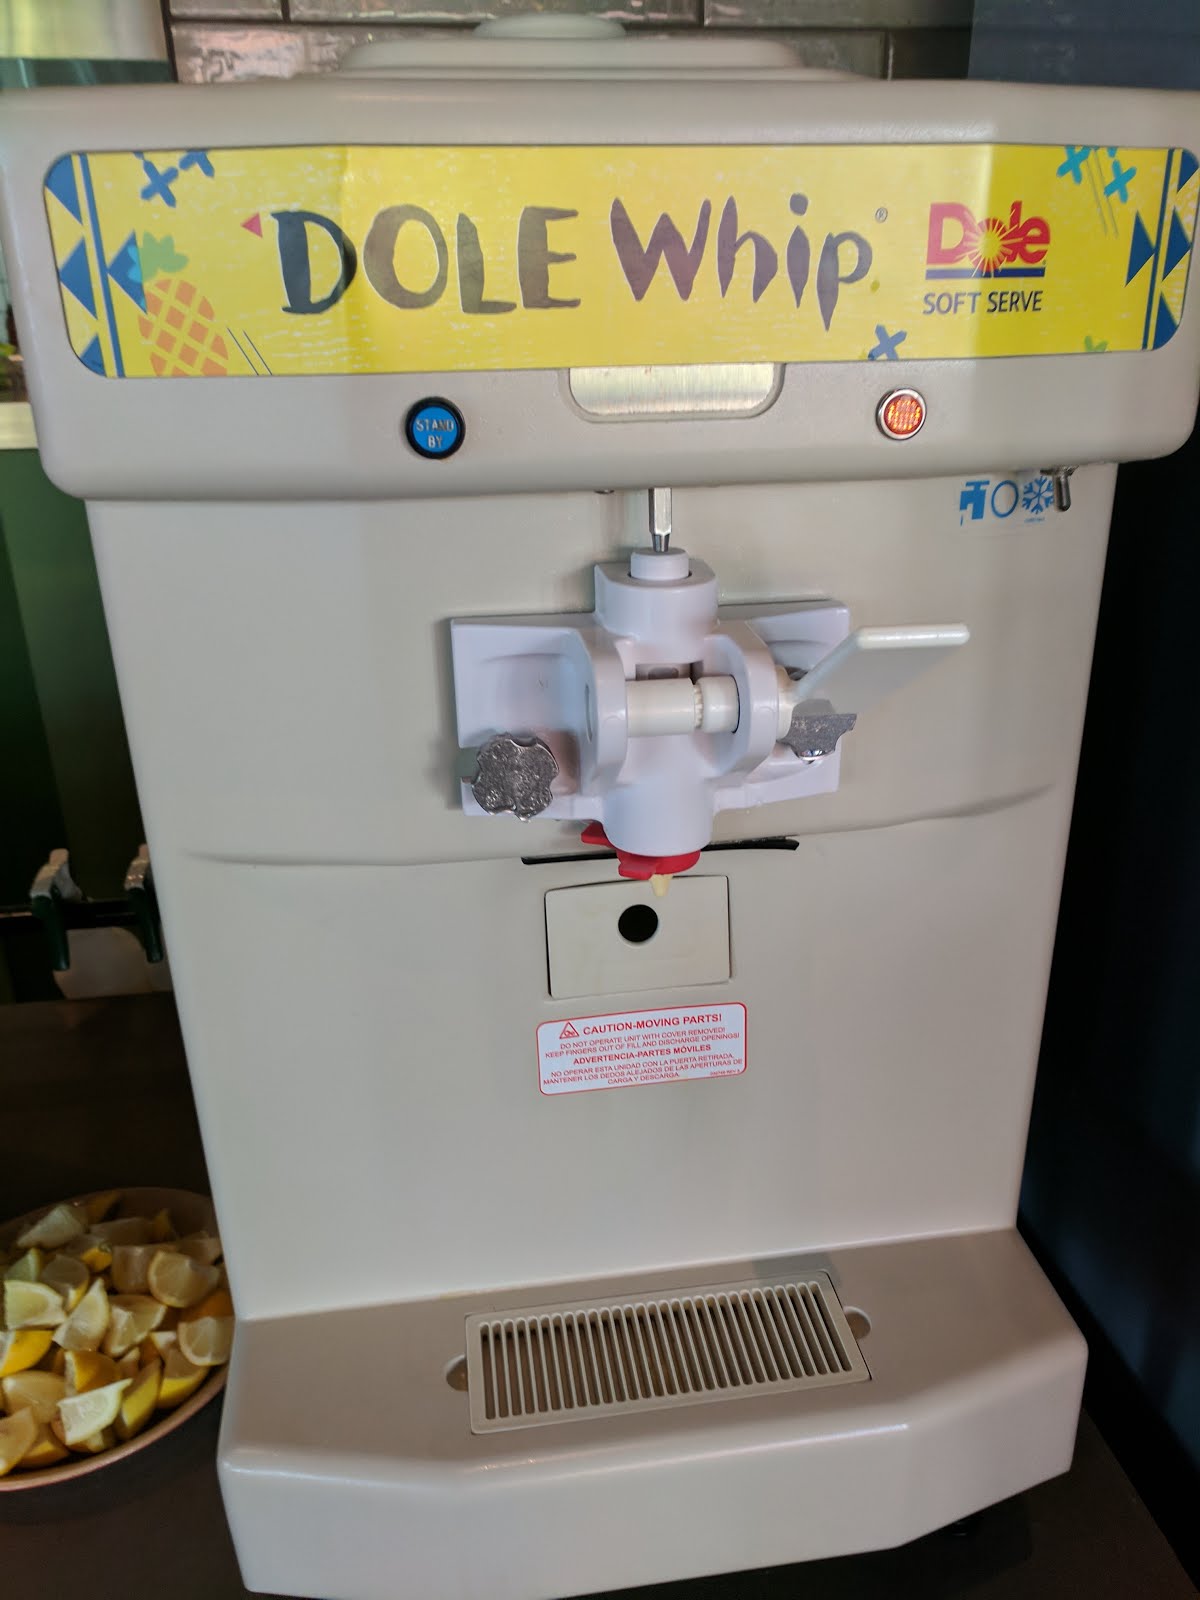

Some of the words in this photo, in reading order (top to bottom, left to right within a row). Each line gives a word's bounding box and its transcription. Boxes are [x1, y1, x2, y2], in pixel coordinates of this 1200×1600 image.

[926, 201, 1050, 272] Dole
[271, 204, 581, 315] DOLE
[609, 192, 872, 332] Whip
[923, 292, 981, 315] SOFT
[987, 290, 1043, 313] SERVE
[415, 418, 454, 432] STAND
[427, 435, 442, 448] BY
[583, 1017, 680, 1035] CAUTION-MOVING
[683, 1013, 722, 1024] PARTS!
[566, 1047, 597, 1056] FINGERS
[658, 1036, 700, 1046] DISCHARGE
[701, 1033, 740, 1041] OPENINGS!
[590, 1037, 623, 1046] OPERATE
[661, 1030, 687, 1038] COVER
[688, 1027, 726, 1035] REMOVED!
[573, 1048, 671, 1065] ADVERTENCIA-PARTES
[673, 1044, 711, 1054] MÓVILES
[543, 1076, 583, 1085] MANTENER
[600, 1071, 624, 1079] DEDOS
[626, 1067, 662, 1076] ALEJADOS
[690, 1059, 731, 1069] APERTURAS
[563, 1067, 593, 1076] OPERAR
[614, 1062, 641, 1070] UNIDAD
[670, 1056, 697, 1064] PUERTA
[640, 1072, 679, 1080] DESCARGA
